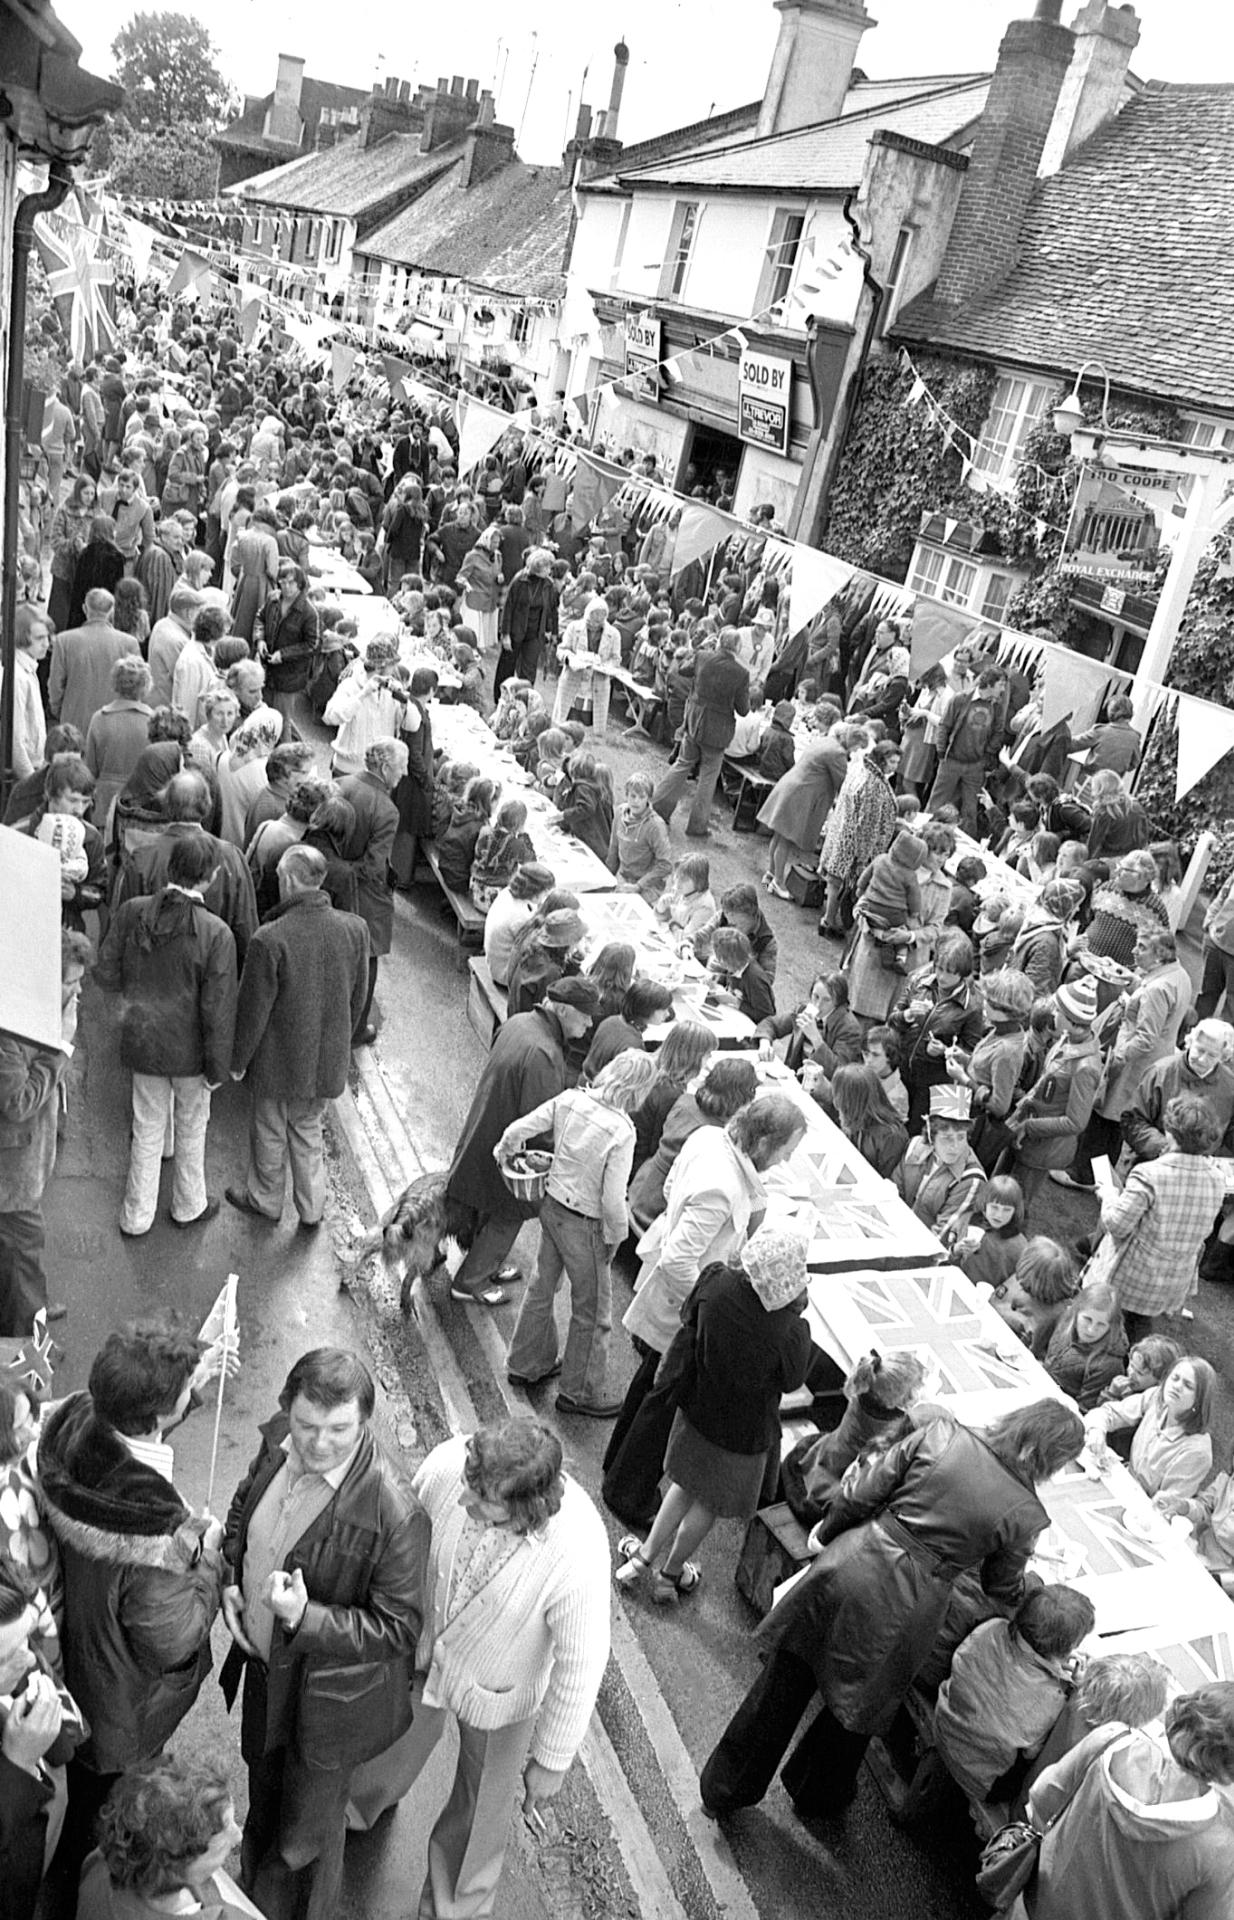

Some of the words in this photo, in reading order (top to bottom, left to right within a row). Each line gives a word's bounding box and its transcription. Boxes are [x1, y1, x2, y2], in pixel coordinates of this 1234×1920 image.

[644, 330, 655, 347] BY
[743, 361, 769, 385] SOLD
[771, 368, 785, 390] BY
[1123, 474, 1170, 489] COOPE
[1060, 563, 1094, 575] ROYAL
[1096, 566, 1154, 581] EXCHANGE
